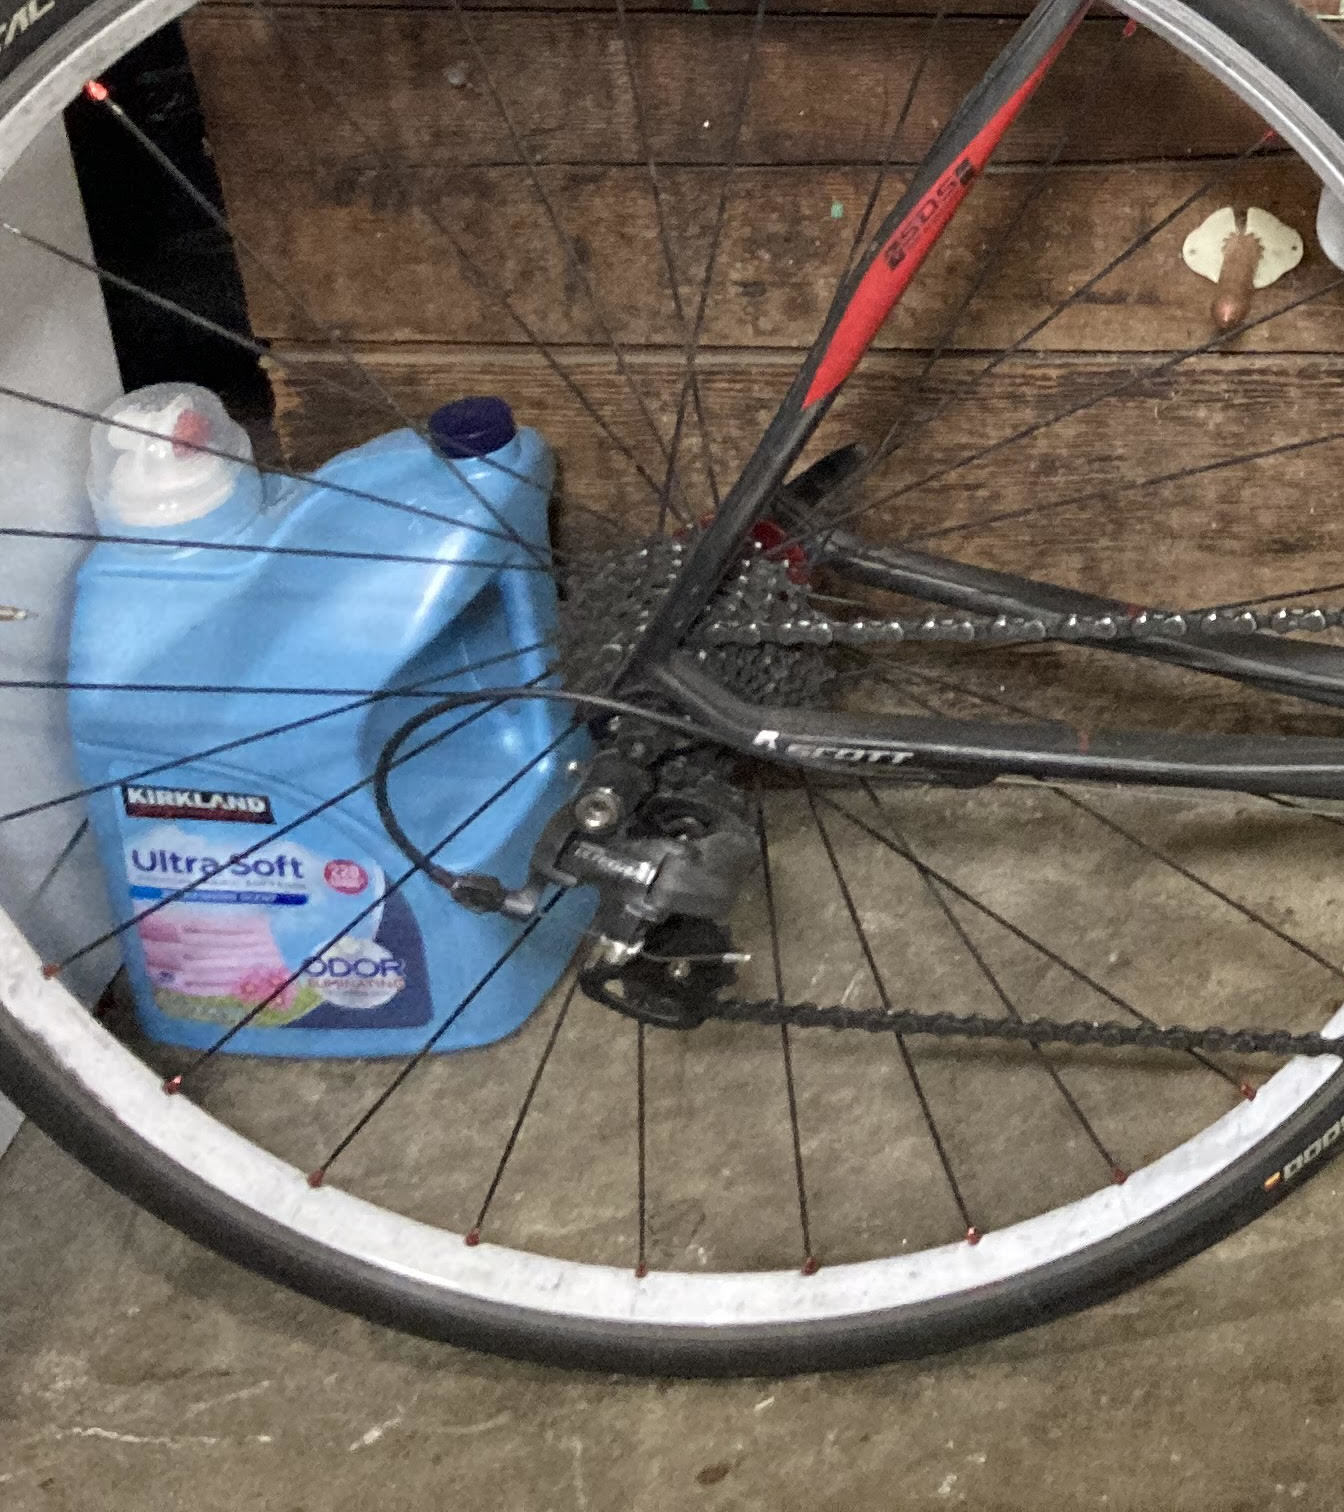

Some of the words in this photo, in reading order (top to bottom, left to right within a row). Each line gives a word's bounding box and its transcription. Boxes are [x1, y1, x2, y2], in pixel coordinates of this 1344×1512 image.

[127, 787, 268, 813] KIRKLAND
[131, 848, 220, 875] Ultra
[229, 854, 304, 879] Soft
[303, 957, 405, 978] ODOR
